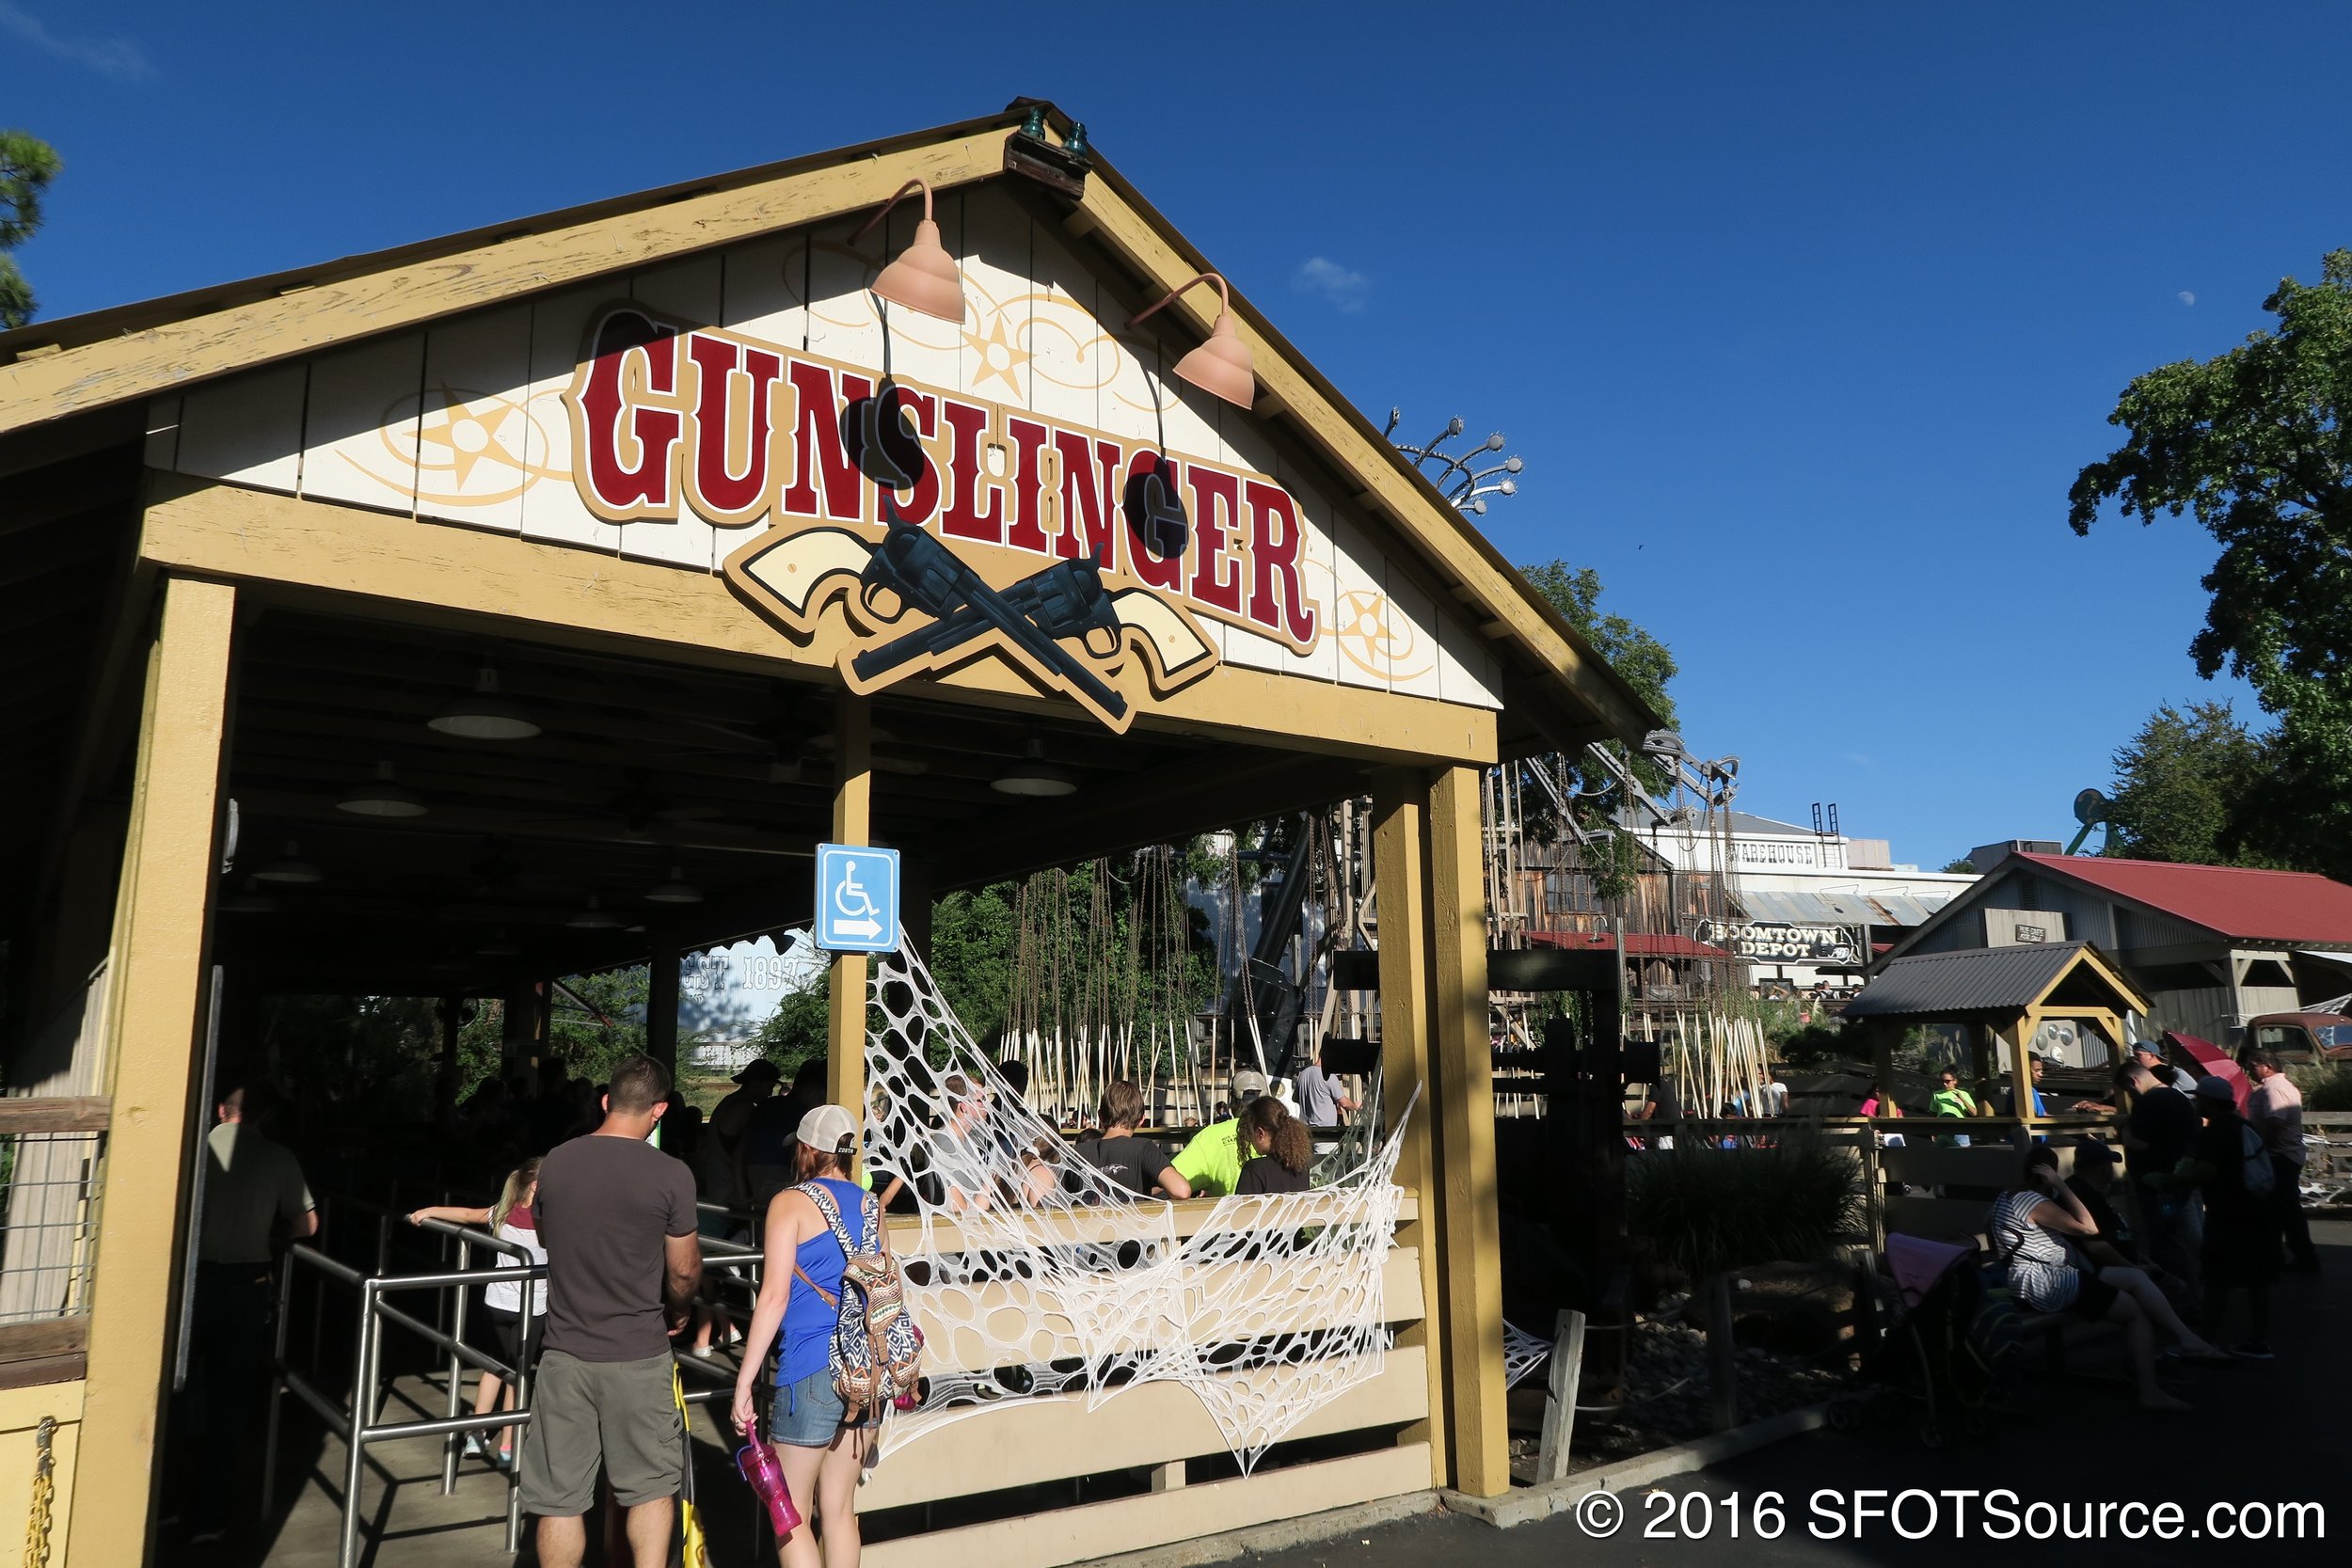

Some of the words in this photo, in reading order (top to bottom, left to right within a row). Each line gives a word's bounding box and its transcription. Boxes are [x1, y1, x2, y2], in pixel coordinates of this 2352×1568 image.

[578, 309, 1314, 646] GUNSLINGER
[1730, 843, 1812, 864] WAREHOUSE
[1709, 925, 1839, 945] BOOMTOWN
[1740, 941, 1811, 958] DEPOT
